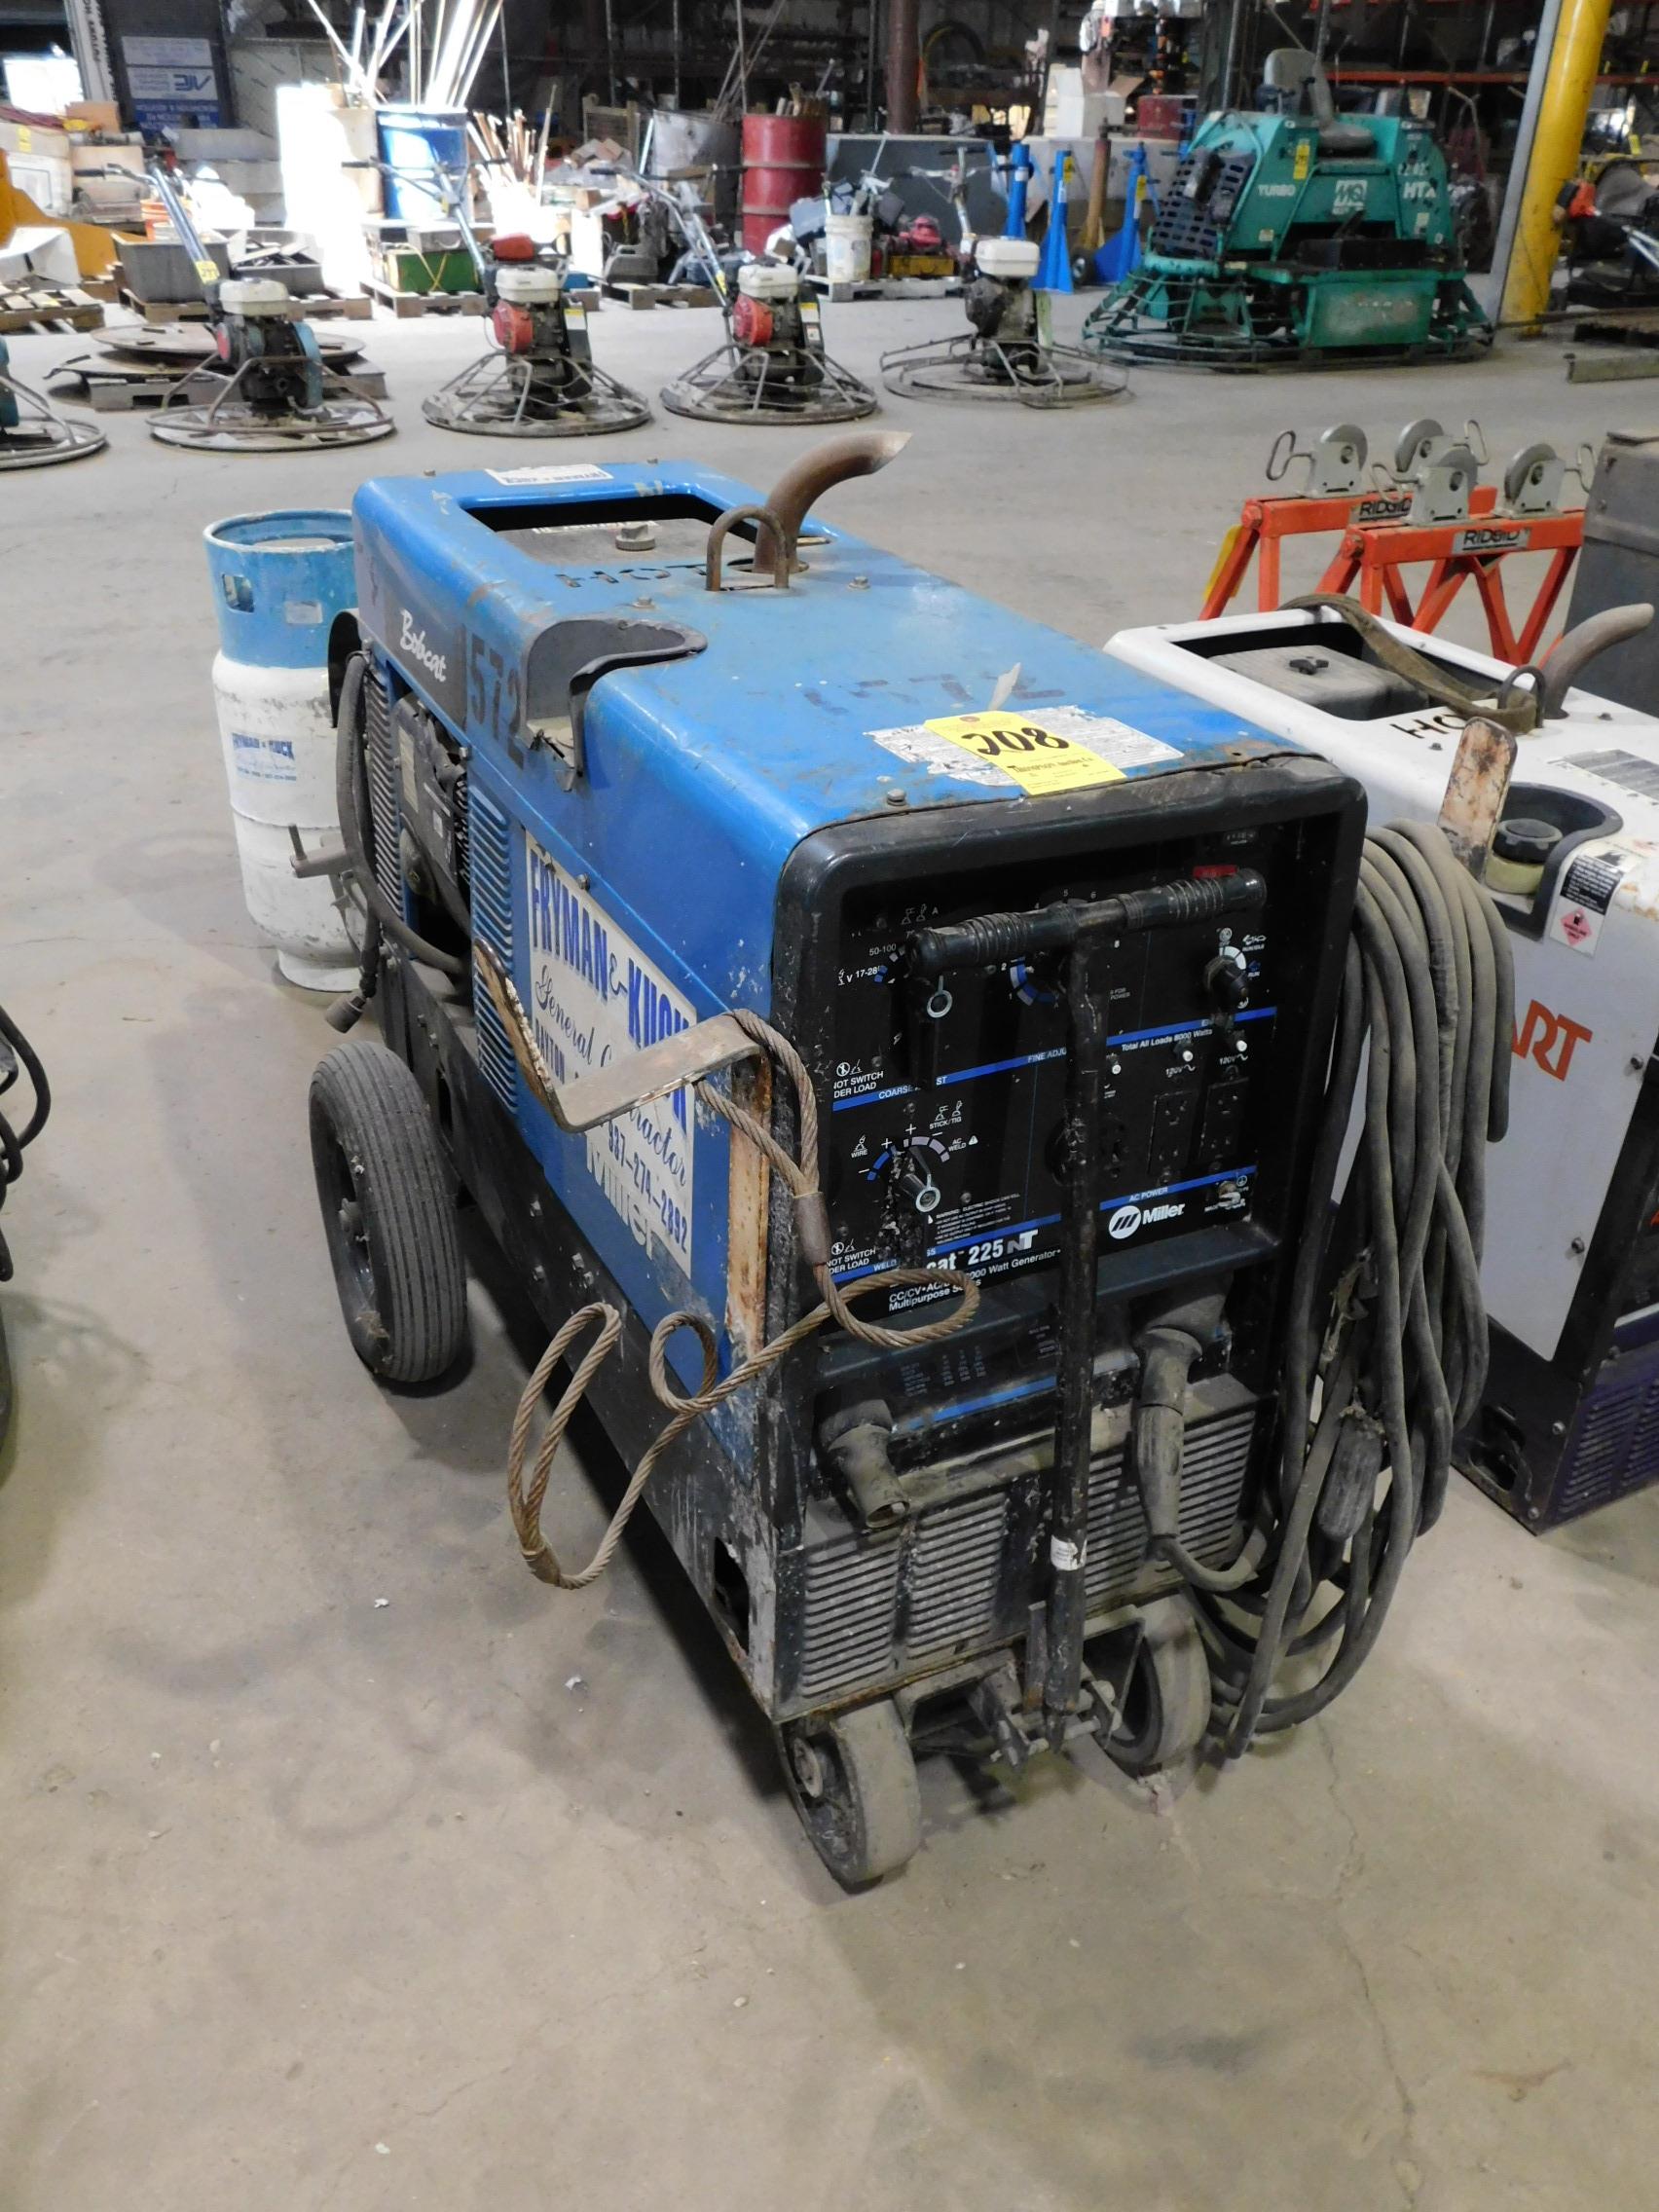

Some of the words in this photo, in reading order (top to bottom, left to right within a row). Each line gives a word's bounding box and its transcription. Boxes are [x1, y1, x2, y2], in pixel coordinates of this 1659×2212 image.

[1463, 530, 1519, 545] RIDGID
[399, 608, 447, 682] Bobcat
[961, 727, 1070, 756] 208
[531, 849, 608, 1002] FRYMAN
[1122, 1041, 1138, 1052] Total
[1140, 1038, 1150, 1049] All
[850, 1070, 884, 1086] SWITCH
[833, 1088, 852, 1099] DER
[854, 1082, 877, 1094] LOAD
[851, 1149, 868, 1159] WIRE
[948, 1142, 967, 1154] WELD
[1128, 1193, 1140, 1202] AC
[1140, 1187, 1169, 1200] POWER
[1142, 1203, 1186, 1226] Miller
[844, 1246, 876, 1263] SWITCH
[968, 1238, 1004, 1266] 225
[829, 1266, 846, 1275] DER
[847, 1258, 870, 1271] LOAD
[968, 1268, 987, 1280] 000
[988, 1263, 1010, 1274] Watt
[889, 1286, 950, 1312] Multipurpose
